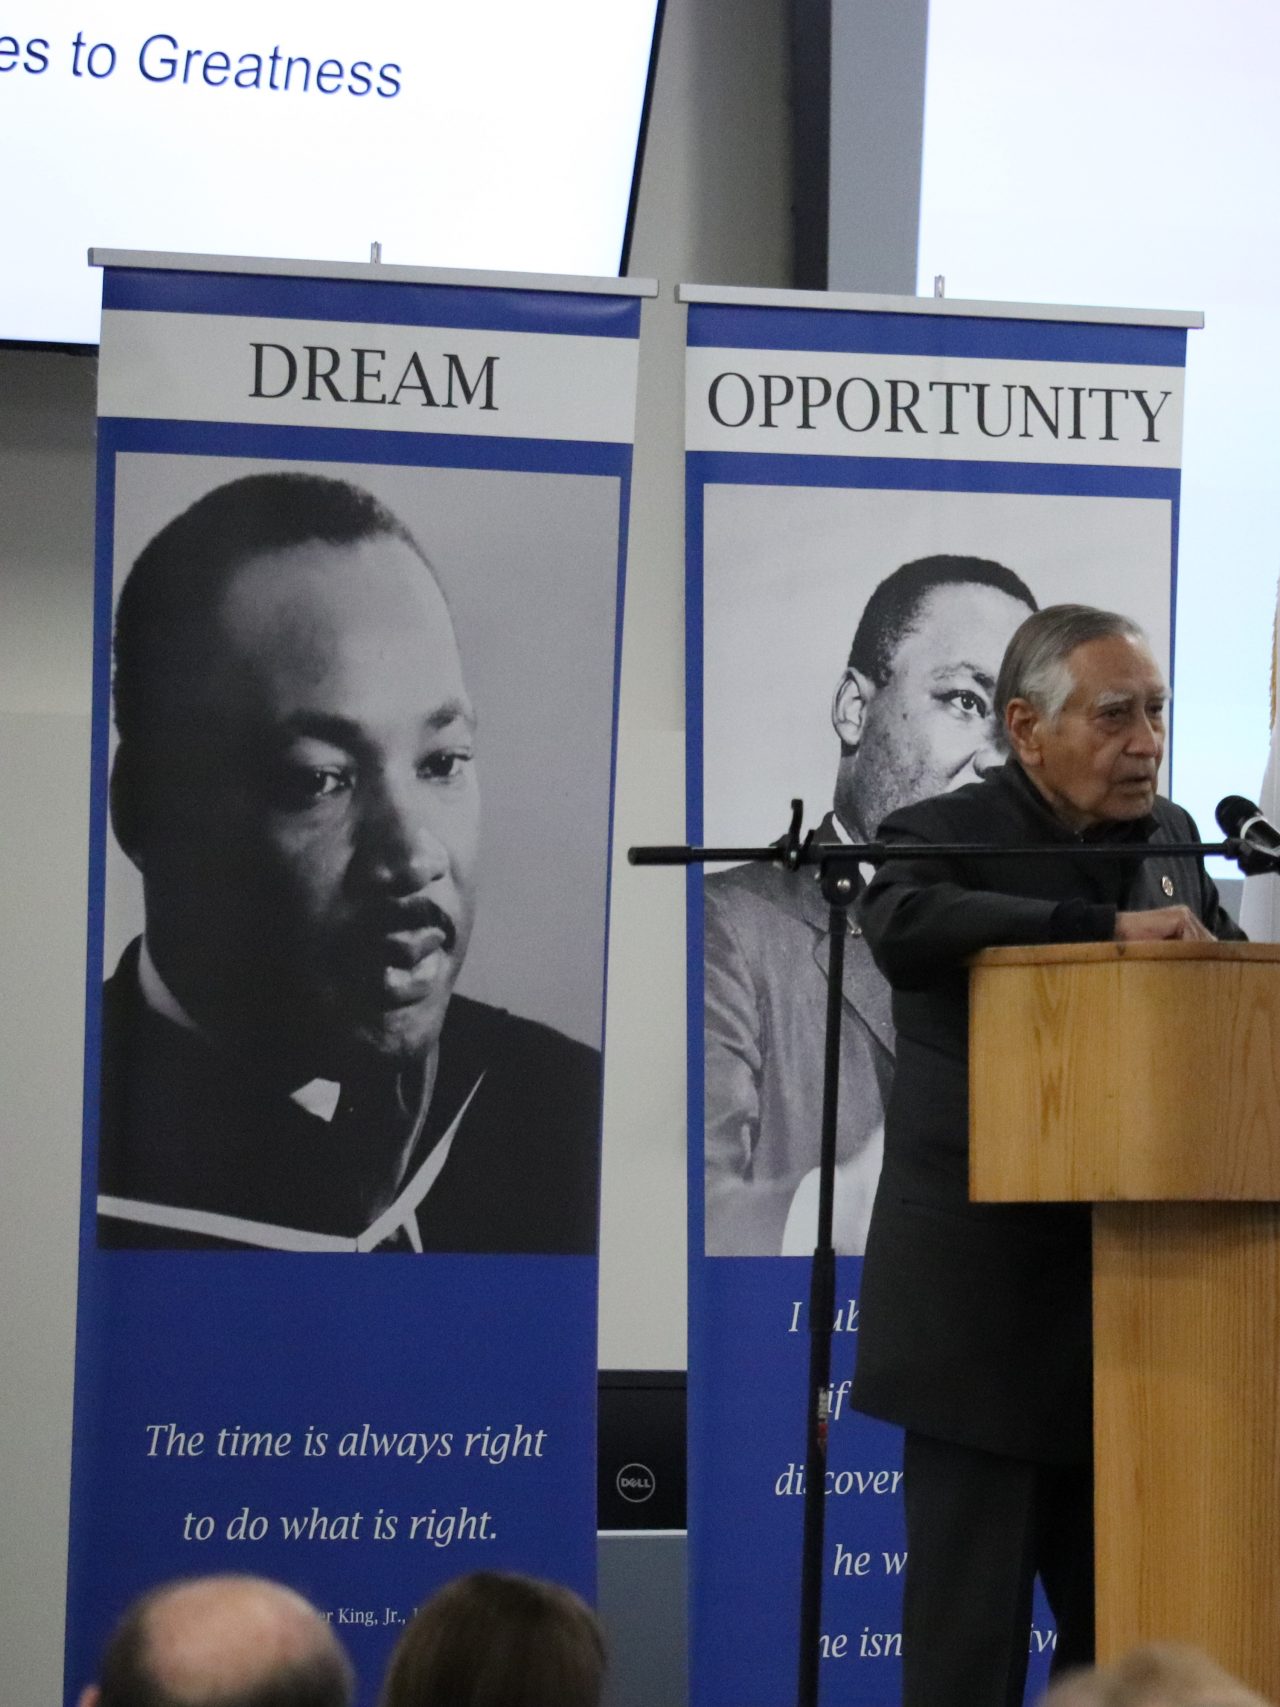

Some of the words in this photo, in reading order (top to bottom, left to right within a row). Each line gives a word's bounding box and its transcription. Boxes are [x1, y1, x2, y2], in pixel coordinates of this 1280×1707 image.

[72, 32, 117, 78] to
[139, 33, 402, 98] Greatness
[248, 342, 500, 411] DREAM
[707, 371, 1173, 443] OPPORTUNITY
[788, 1301, 803, 1332] I
[827, 1380, 852, 1420] if
[146, 1423, 205, 1457] The
[217, 1425, 292, 1457] time
[304, 1425, 329, 1457] is
[338, 1423, 454, 1464] always
[464, 1424, 548, 1465] right
[620, 1477, 651, 1489] DELL
[183, 1511, 215, 1541] to
[226, 1507, 269, 1541] do
[279, 1507, 364, 1540] what
[373, 1508, 399, 1540] is
[409, 1506, 498, 1548] right.
[833, 1543, 871, 1576] he
[338, 1607, 378, 1627] King,
[382, 1607, 406, 1626] Jr.,
